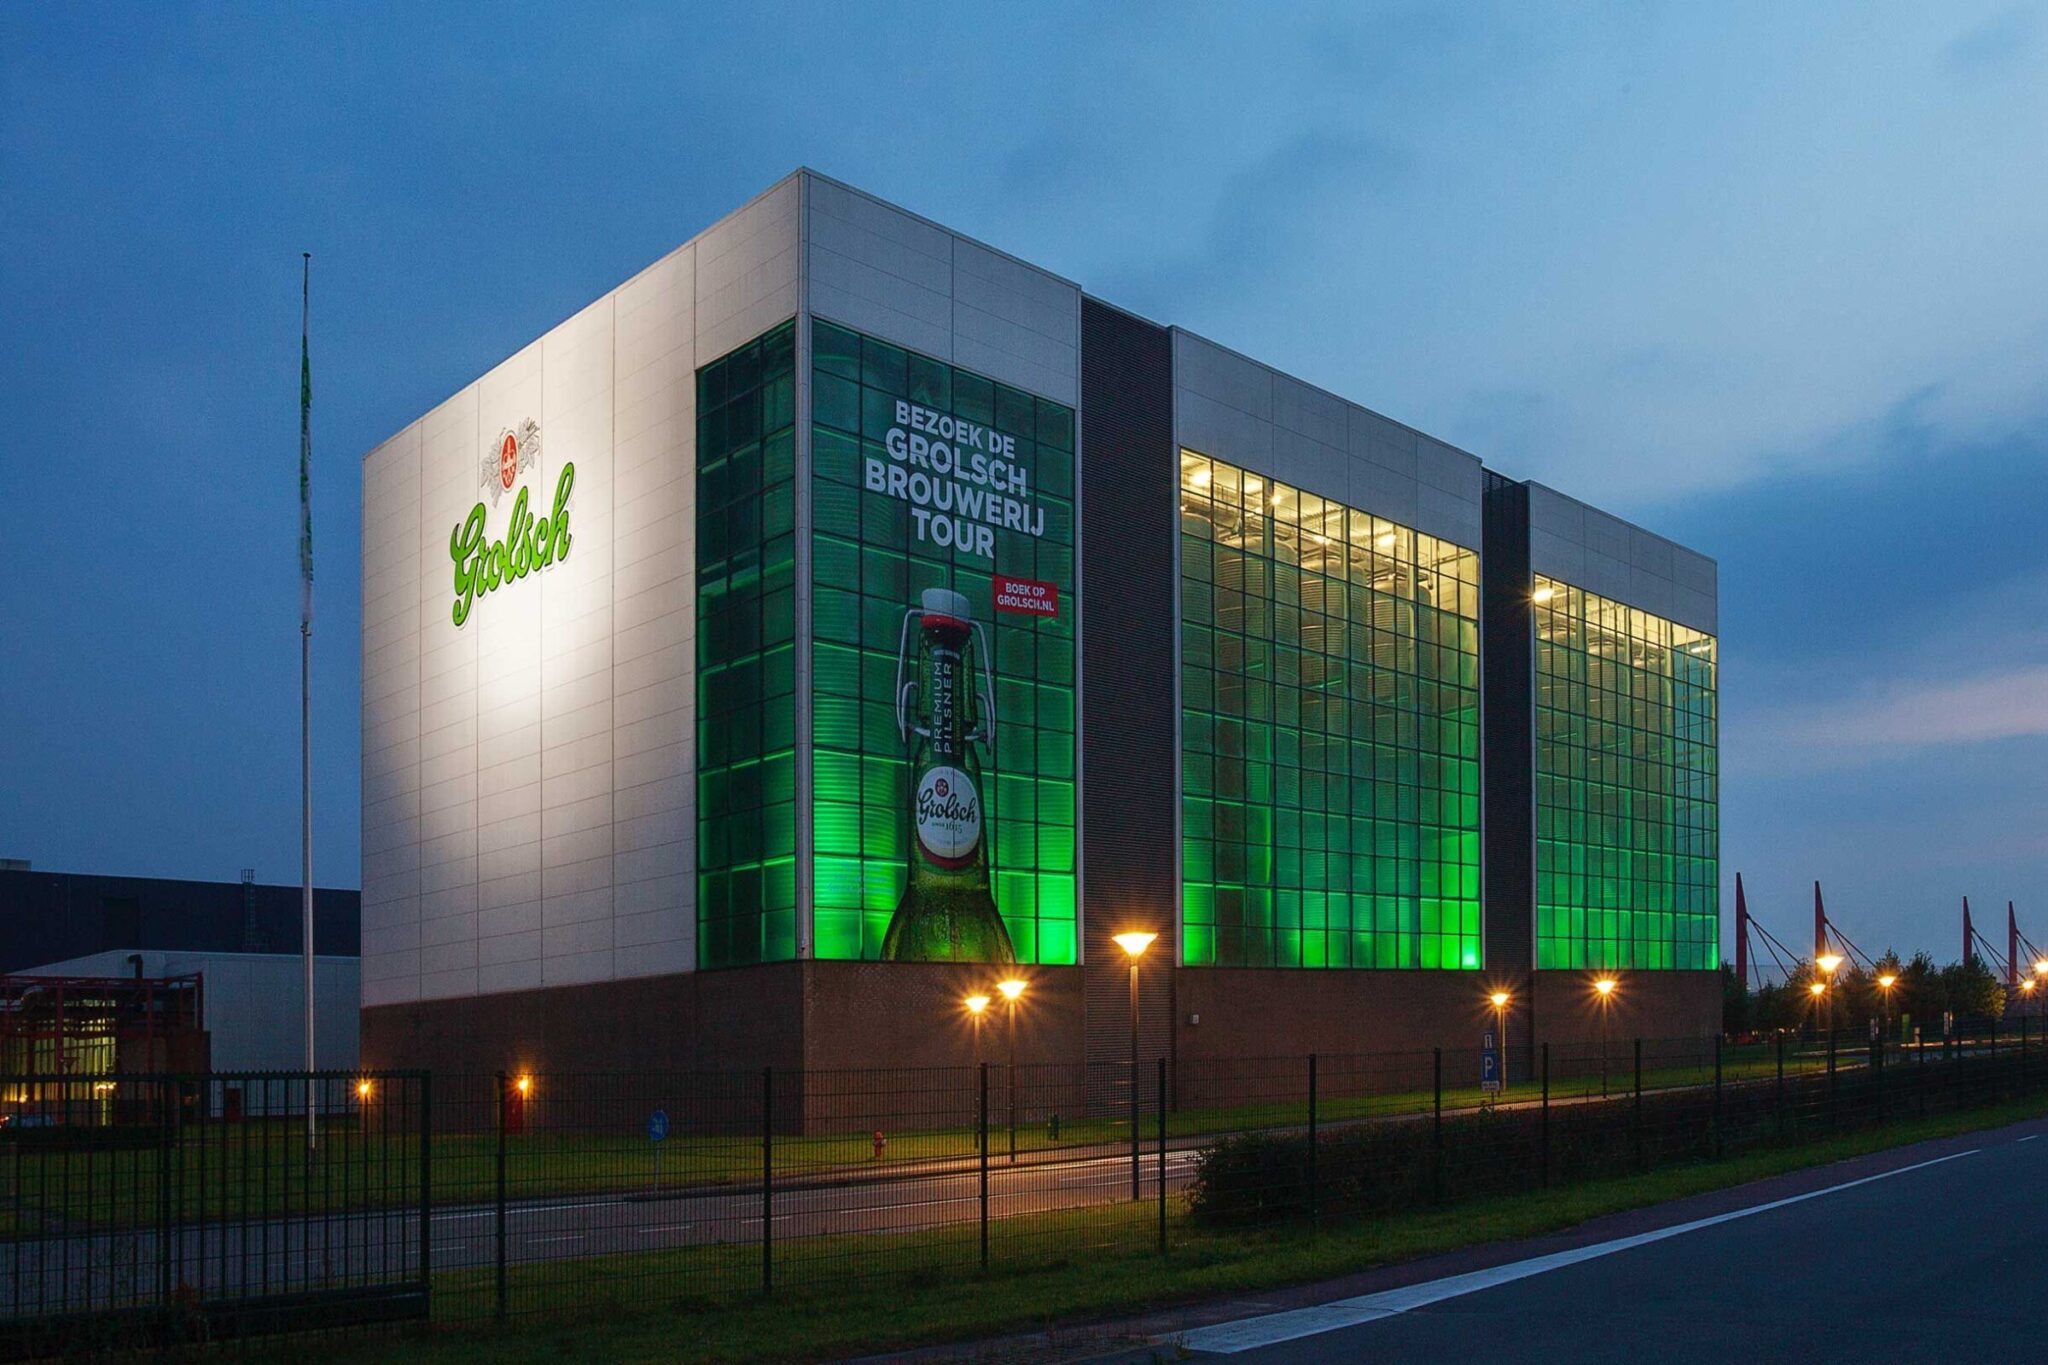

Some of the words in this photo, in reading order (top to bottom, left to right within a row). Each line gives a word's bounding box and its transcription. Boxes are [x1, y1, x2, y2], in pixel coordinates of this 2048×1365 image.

[896, 400, 983, 449] BEZOEK
[988, 430, 1015, 459] DE
[886, 427, 1026, 497] GROLSCH
[865, 457, 1044, 537] BROUWERIJ
[450, 462, 574, 627] Grolsch
[911, 508, 994, 559] TOUR
[997, 595, 1055, 612] GROLSCH.NL
[1005, 582, 1031, 596] BOEK
[1032, 586, 1045, 597] OP
[934, 662, 942, 752] PREMIUM
[944, 663, 952, 753] PILSNER
[917, 788, 976, 825] Grolsch
[1484, 1057, 1494, 1078] P
